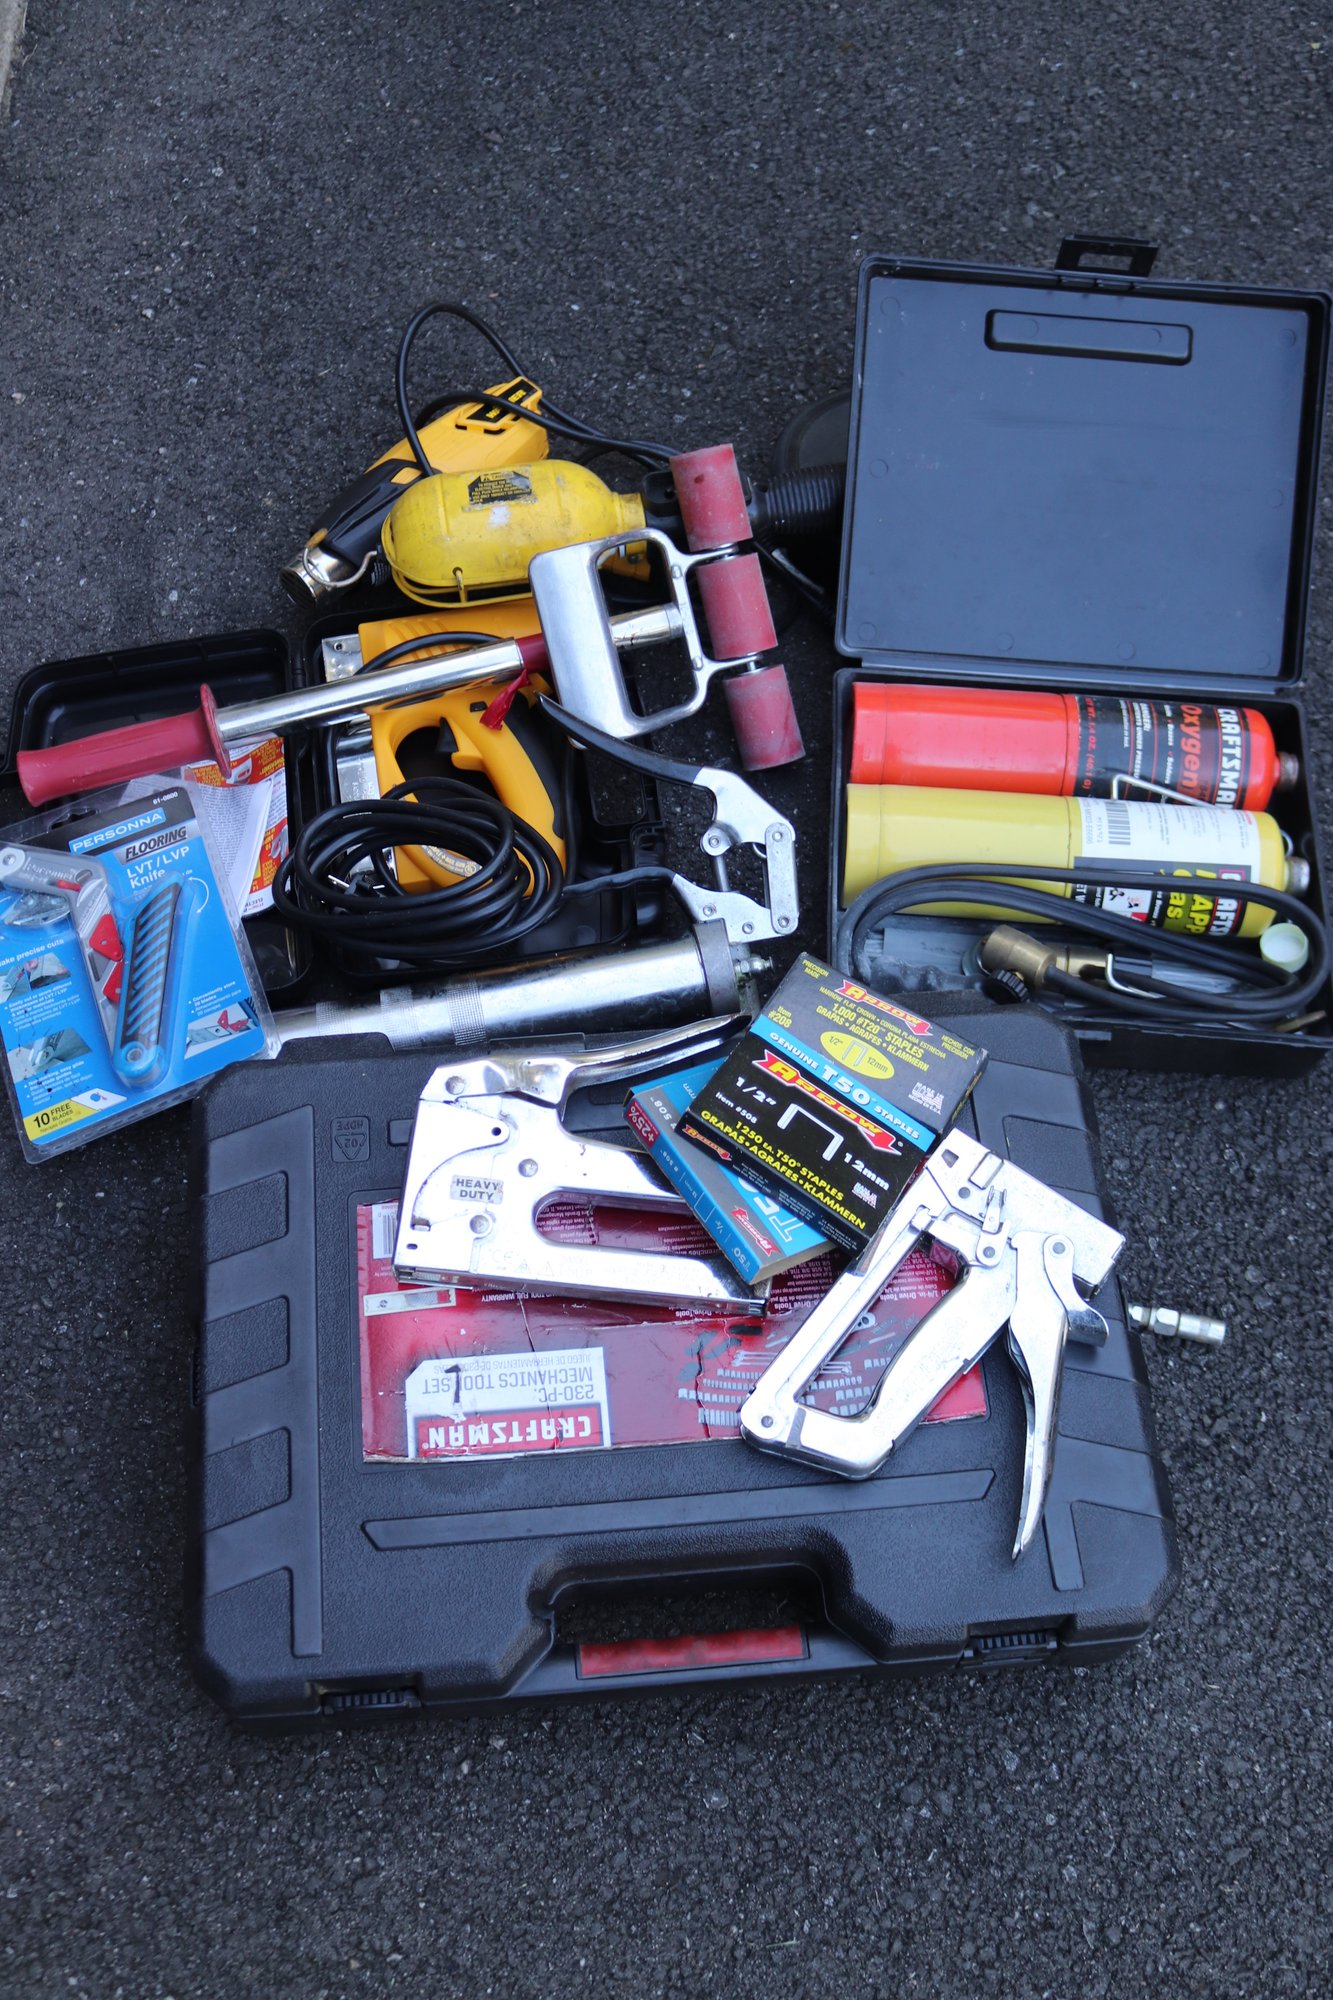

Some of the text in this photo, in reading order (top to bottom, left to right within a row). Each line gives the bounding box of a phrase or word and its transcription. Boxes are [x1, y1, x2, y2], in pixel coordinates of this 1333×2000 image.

[1180, 704, 1203, 788] Oxygen
[72, 812, 163, 853] PERSONNA
[125, 826, 187, 860] FLOORING
[127, 857, 154, 878] LVT
[163, 846, 190, 864] LVP
[130, 867, 166, 889] Knife
[16, 945, 46, 962] precise
[47, 938, 65, 949] cuts
[802, 959, 830, 977] PRECISION
[804, 967, 820, 979] MADE
[768, 1010, 793, 1028] #208
[777, 1006, 792, 1018] Item
[820, 986, 946, 1060] NARROW FLAT CROWN CORONA PLANA ESTRECHA
[816, 1005, 930, 1072] GRAPAS AGRAFES KLAMMERN
[885, 1031, 924, 1058] STAPLES
[941, 1042, 969, 1060] PRECISION
[963, 1046, 976, 1057] CON
[867, 1056, 888, 1073] 12mm
[769, 1032, 819, 1070] GENUINE
[873, 1104, 921, 1140] STAPLES
[768, 1059, 885, 1135] ARROW
[50, 1103, 72, 1116] FREE
[52, 1110, 74, 1122] BLADES
[715, 1091, 758, 1124] Item #508
[33, 1112, 50, 1128] 10
[336, 1120, 364, 1131] HDPE
[628, 1106, 655, 1142] +25%
[736, 1121, 763, 1144] 1250
[762, 1142, 775, 1154] EA.
[800, 1166, 845, 1201] STAPLES
[701, 1110, 746, 1144] GRAPAS
[749, 1144, 800, 1185] AGRAFES
[803, 1181, 867, 1231] KLAMMERN
[844, 1152, 890, 1191] 12mm
[456, 1178, 499, 1191] HEAVY
[459, 1189, 494, 1201] DUTY
[481, 1292, 515, 1302] WARRANTY
[879, 1294, 898, 1302] Tools
[899, 1292, 916, 1300] Drive
[675, 1310, 693, 1319] Tools
[774, 1301, 811, 1310] Drive Tools
[493, 1357, 554, 1369] HERRAMIENTAS
[556, 1356, 566, 1365] DE
[567, 1353, 592, 1365] JUEGO
[422, 1376, 451, 1394] SET
[499, 1366, 593, 1389] MECHANICS
[534, 1384, 595, 1403] 230-PC.
